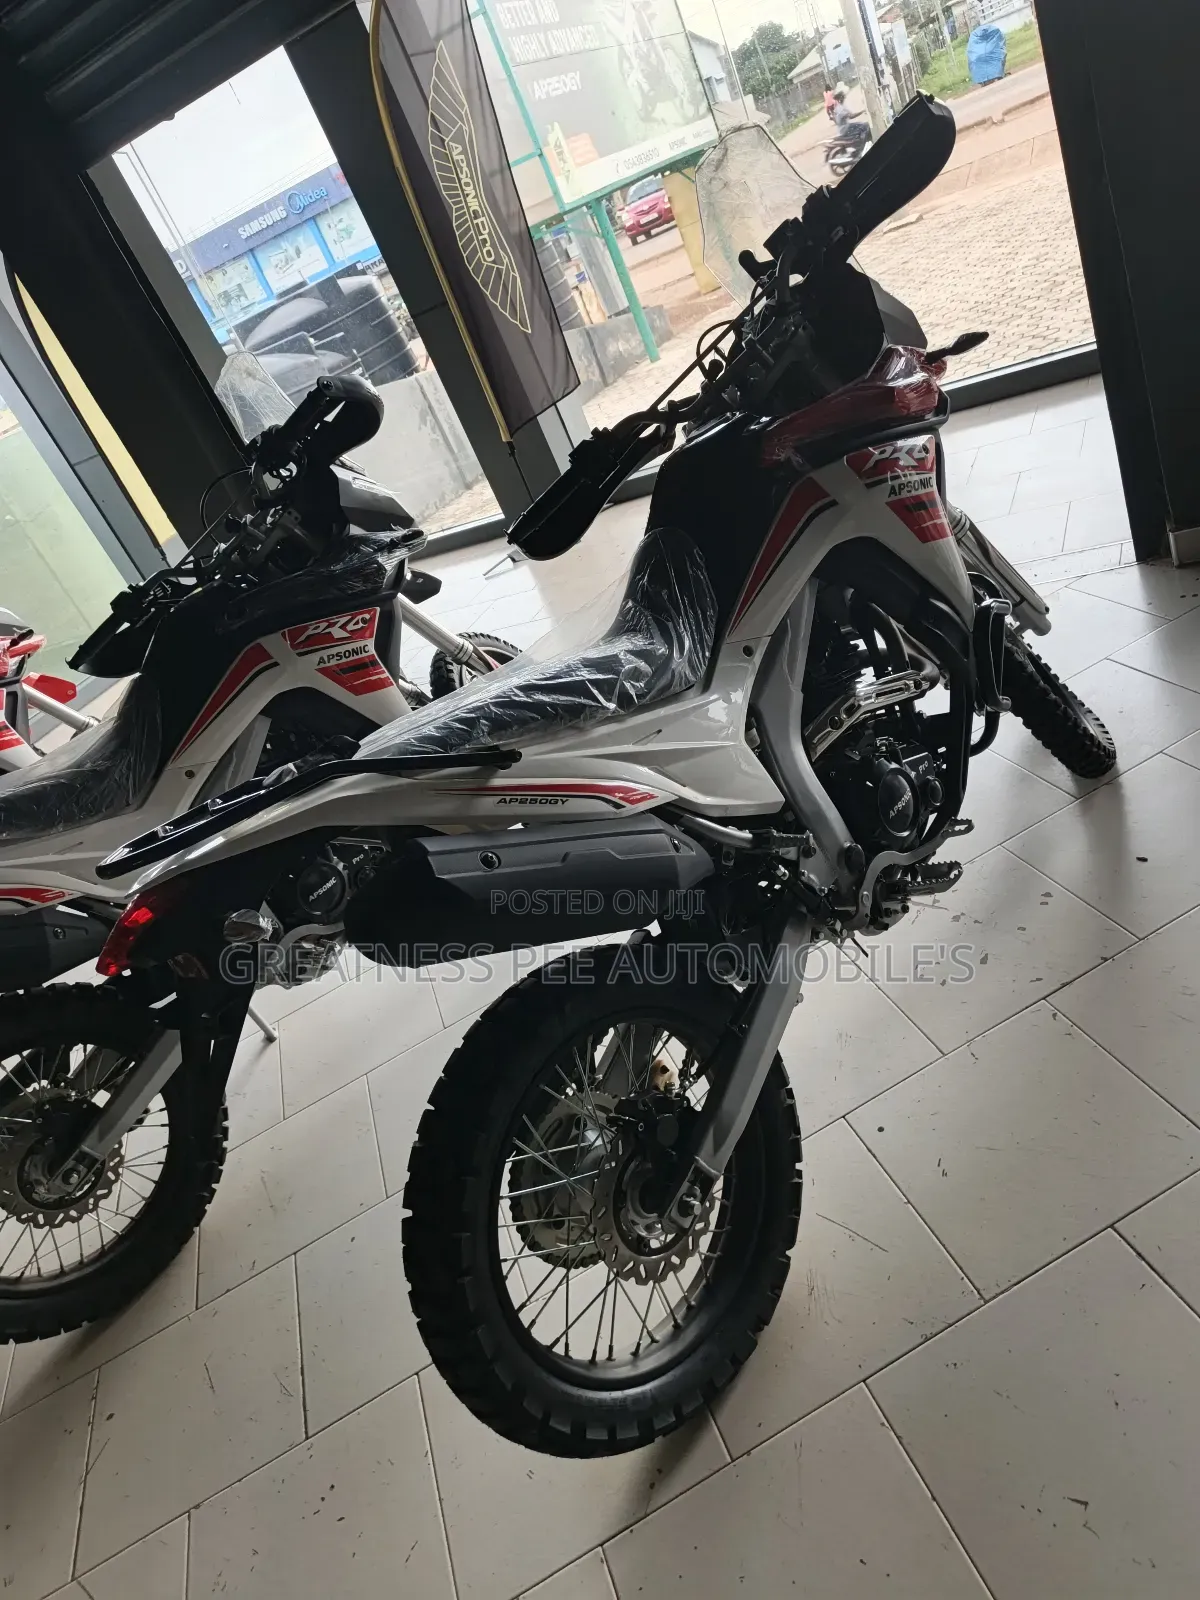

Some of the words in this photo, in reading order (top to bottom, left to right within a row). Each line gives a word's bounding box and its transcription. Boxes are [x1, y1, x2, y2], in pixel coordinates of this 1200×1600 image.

[508, 32, 550, 62] HIGHLY
[237, 205, 288, 240] SAMSUNG
[288, 186, 328, 214] Midea
[449, 142, 482, 217] APSONIC
[473, 216, 495, 262] Pro
[888, 476, 934, 499] APSONIC
[317, 644, 370, 667] APSONIC
[496, 797, 570, 806] AP250GY
[352, 853, 364, 865] Pro
[309, 876, 337, 902] APSONIC
